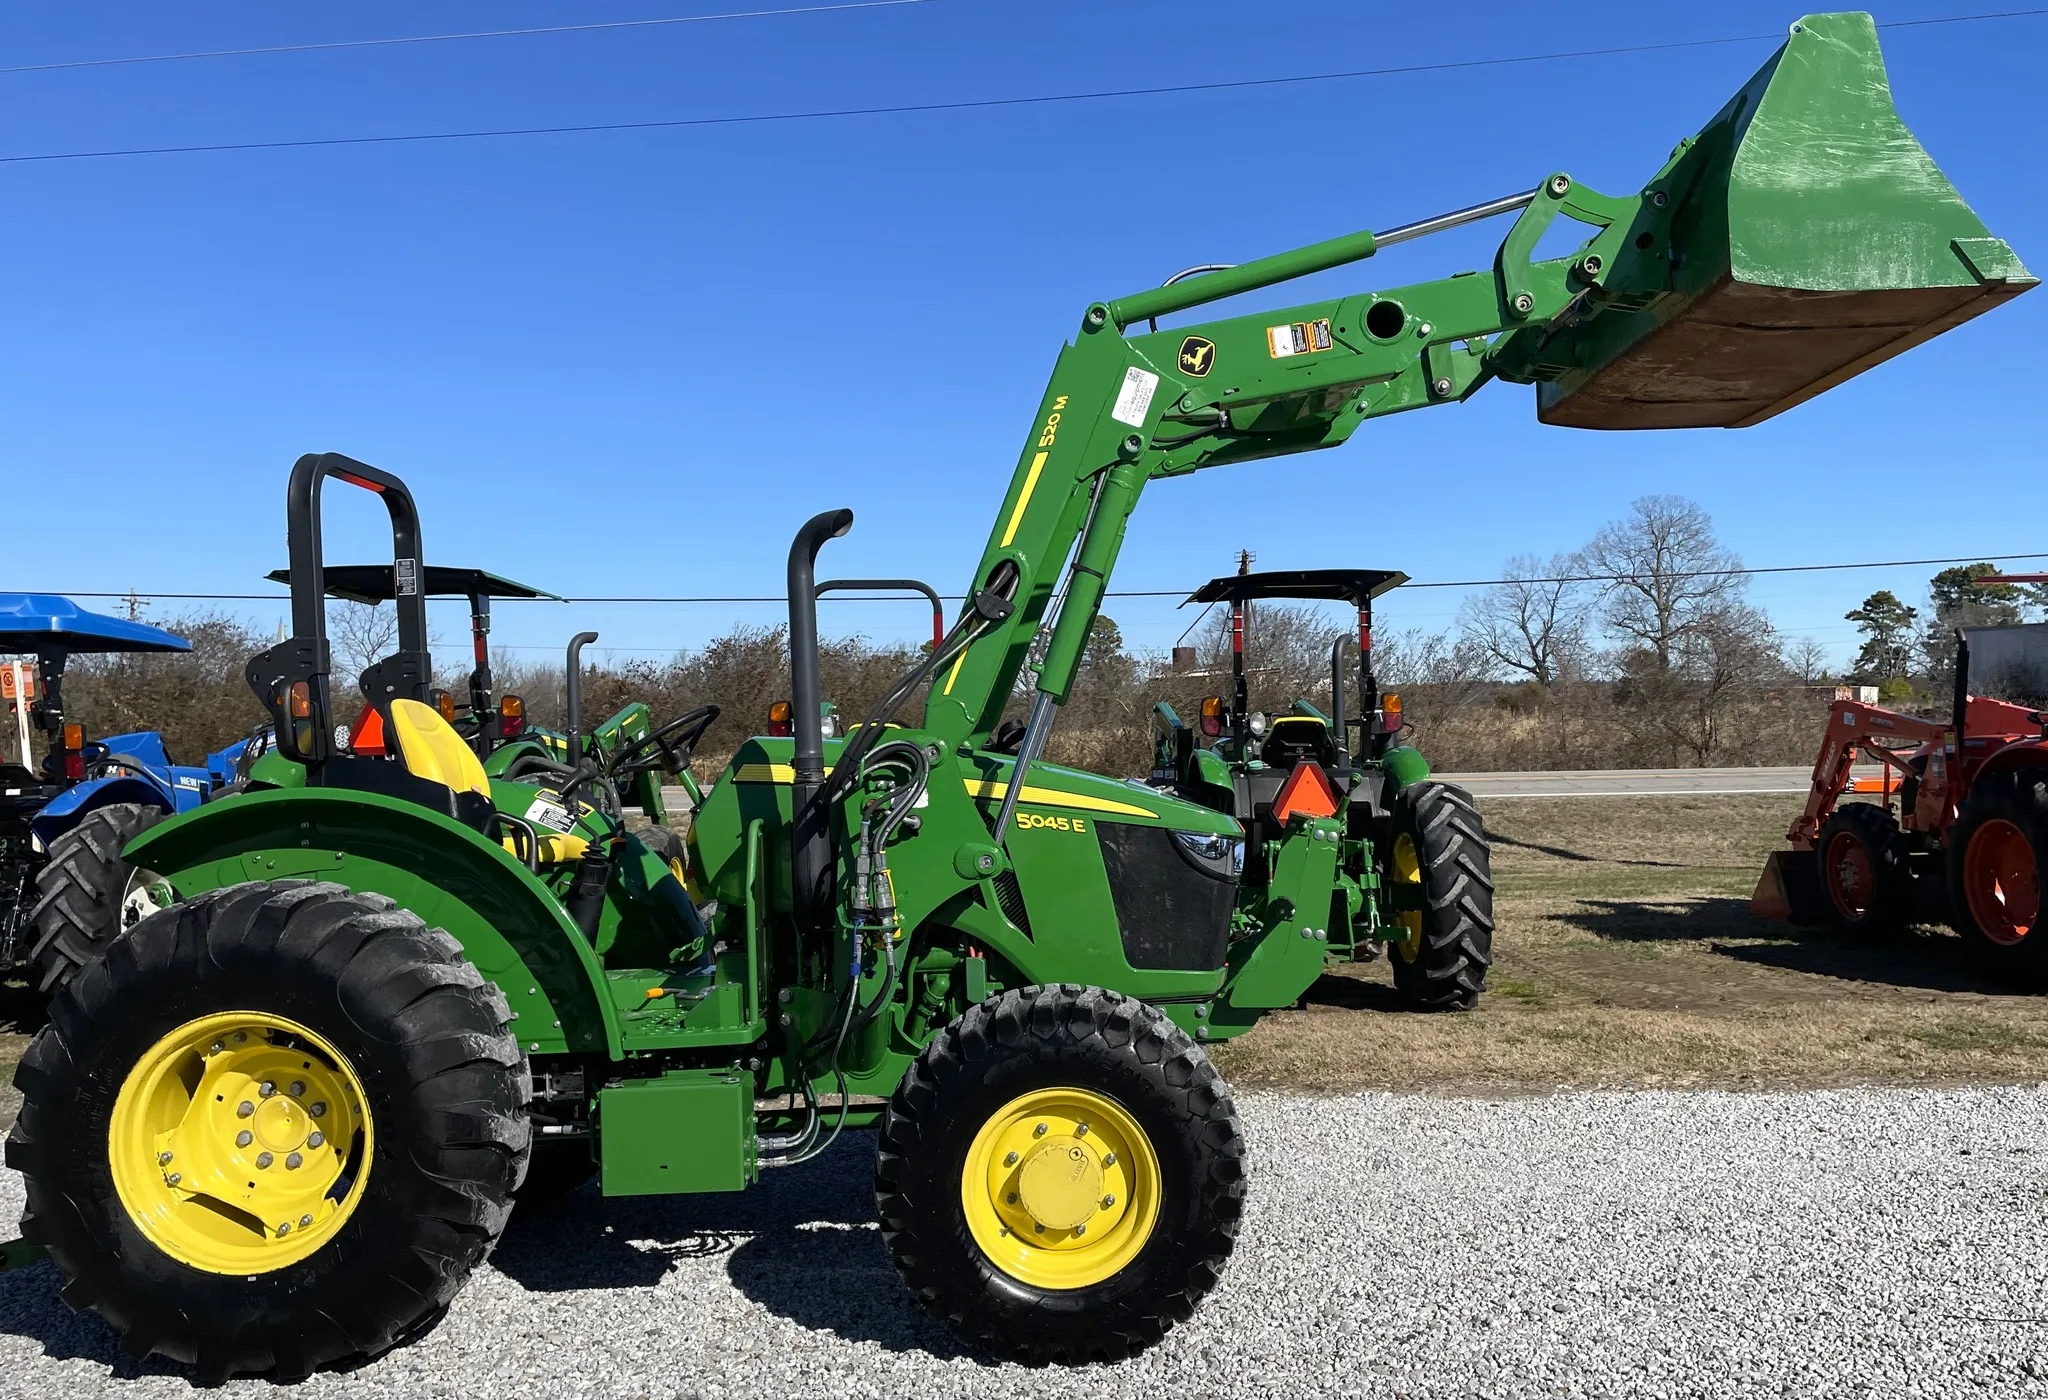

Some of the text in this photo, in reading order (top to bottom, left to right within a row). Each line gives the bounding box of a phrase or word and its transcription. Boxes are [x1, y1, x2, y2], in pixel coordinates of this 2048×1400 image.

[1037, 395, 1069, 447] 520 M
[180, 776, 197, 787] NEW
[1015, 812, 1086, 833] 5045 E
